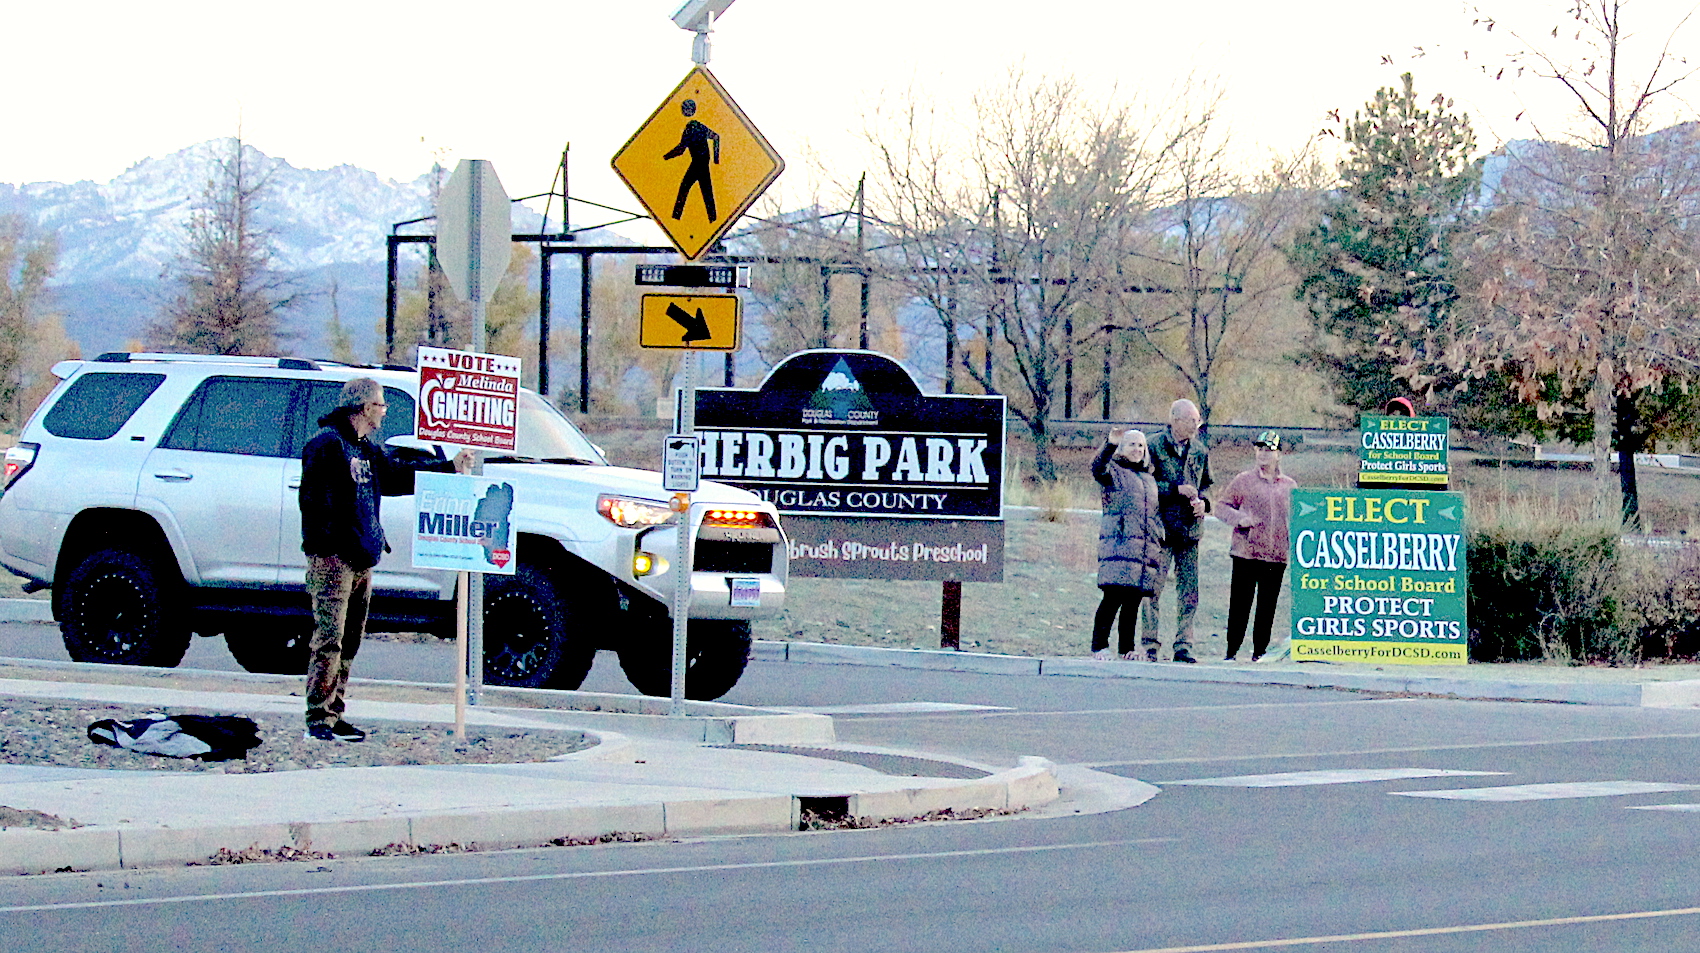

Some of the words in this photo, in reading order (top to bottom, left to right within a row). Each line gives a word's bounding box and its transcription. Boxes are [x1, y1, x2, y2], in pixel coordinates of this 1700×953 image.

[448, 353, 495, 373] VOTE
[458, 374, 513, 393] Melinda
[432, 390, 515, 427] GNEITING
[802, 409, 833, 419] DOUGLAS
[846, 410, 880, 420] COUNTY
[1380, 419, 1429, 431] ELECT
[1362, 431, 1447, 450] CASSELBERRY
[694, 431, 850, 481] HERBIG
[862, 435, 990, 484] PARK
[1368, 450, 1382, 459] for
[1384, 451, 1412, 460] School
[1414, 451, 1440, 461] Board
[1361, 460, 1393, 471] Protect
[1394, 461, 1417, 471] Girls
[1418, 461, 1447, 473] Sports
[846, 491, 948, 510] COUNTY
[1325, 496, 1431, 524] ELECT
[418, 511, 499, 539] Miller
[841, 541, 910, 561] Sprouts
[913, 542, 988, 564] Preschool
[1296, 529, 1461, 571] CASSELBERRY
[1301, 573, 1329, 590] for
[1334, 574, 1396, 592] School
[1401, 576, 1456, 593] Board
[1323, 595, 1435, 617] PROTECT
[1296, 616, 1367, 637] GIRLS
[1371, 618, 1462, 640] SPORTS
[1297, 643, 1461, 660] CasselberryForDCSD.com
